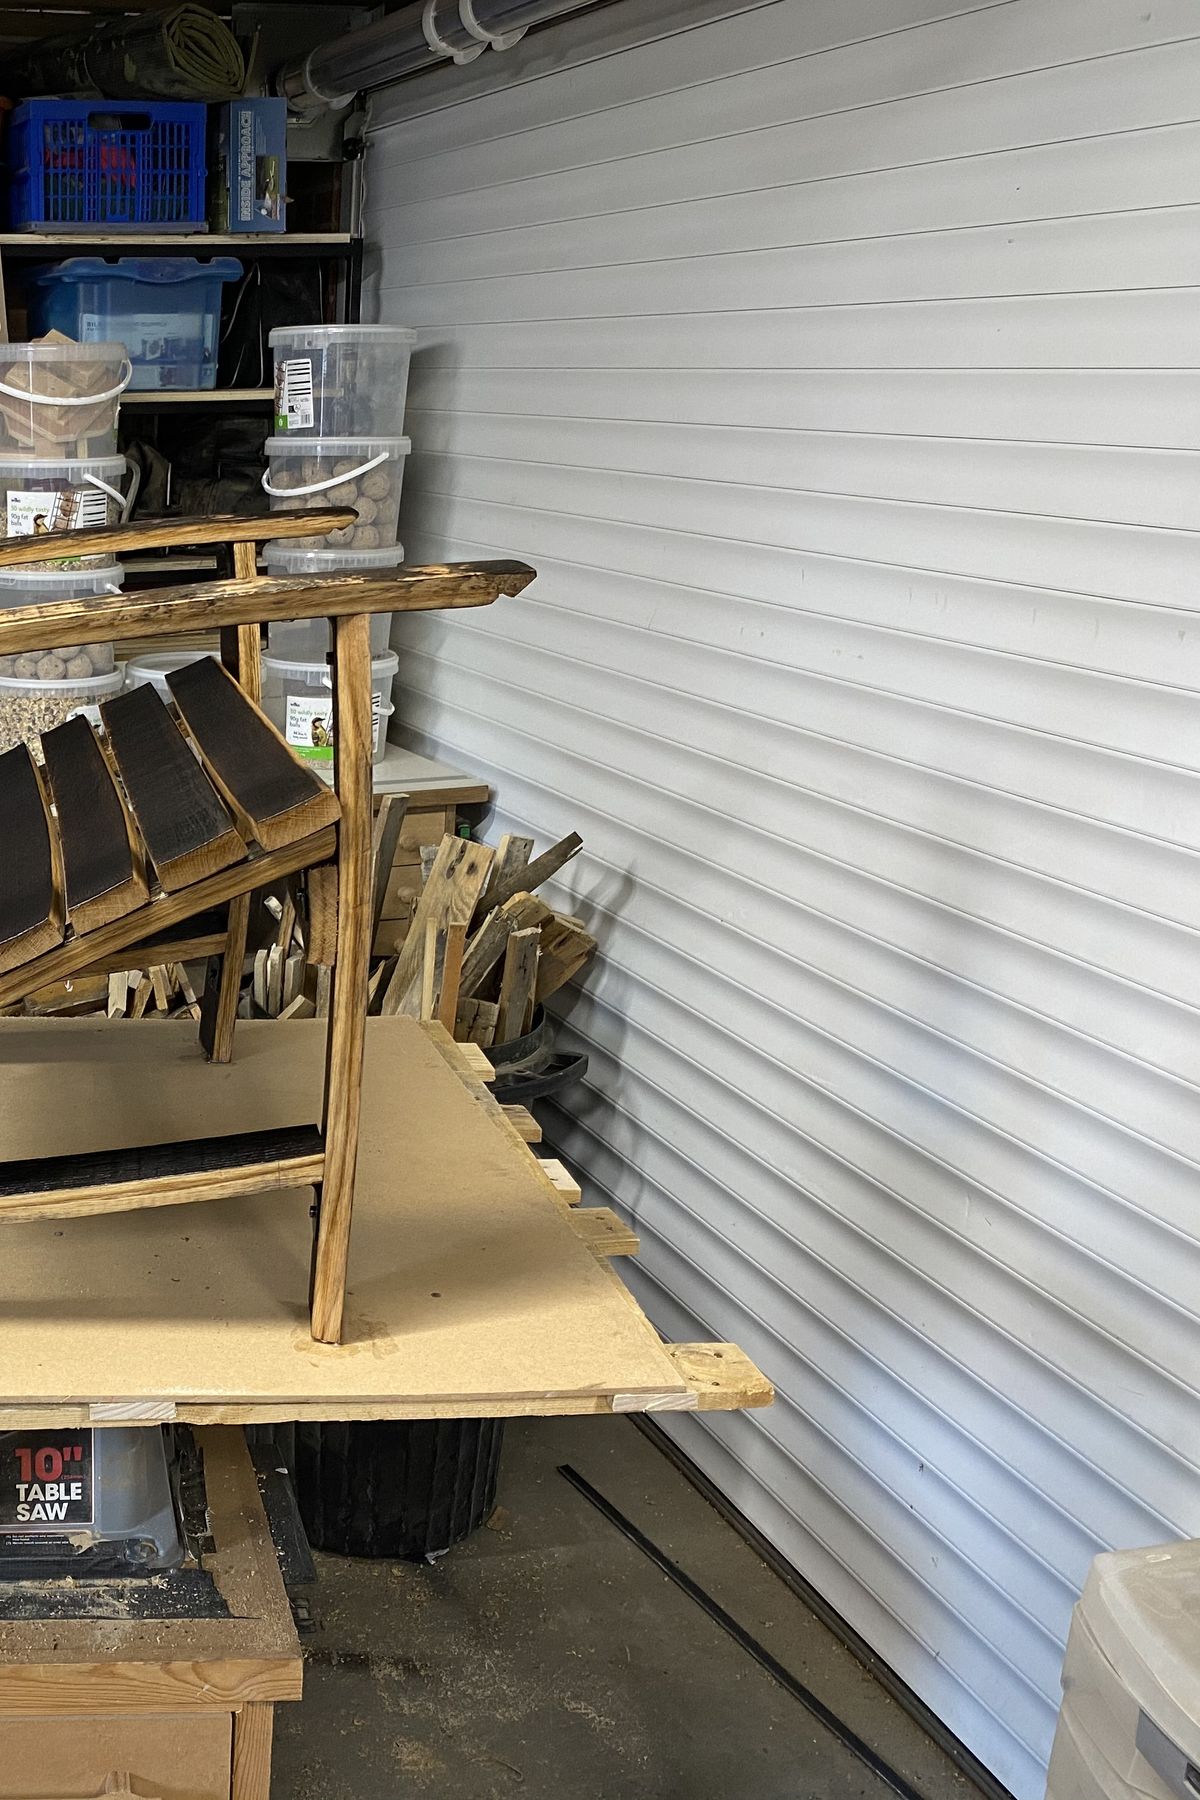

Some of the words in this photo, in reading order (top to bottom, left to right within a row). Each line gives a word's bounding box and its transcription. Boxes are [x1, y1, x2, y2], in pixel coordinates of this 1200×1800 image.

[240, 111, 252, 177] APPROACH
[240, 180, 252, 221] INSIDE
[18, 506, 34, 514] wildly
[290, 716, 299, 724] 90g
[298, 709, 313, 717] wildly
[15, 1482, 82, 1501] TABLE
[16, 1502, 69, 1521] SAW
